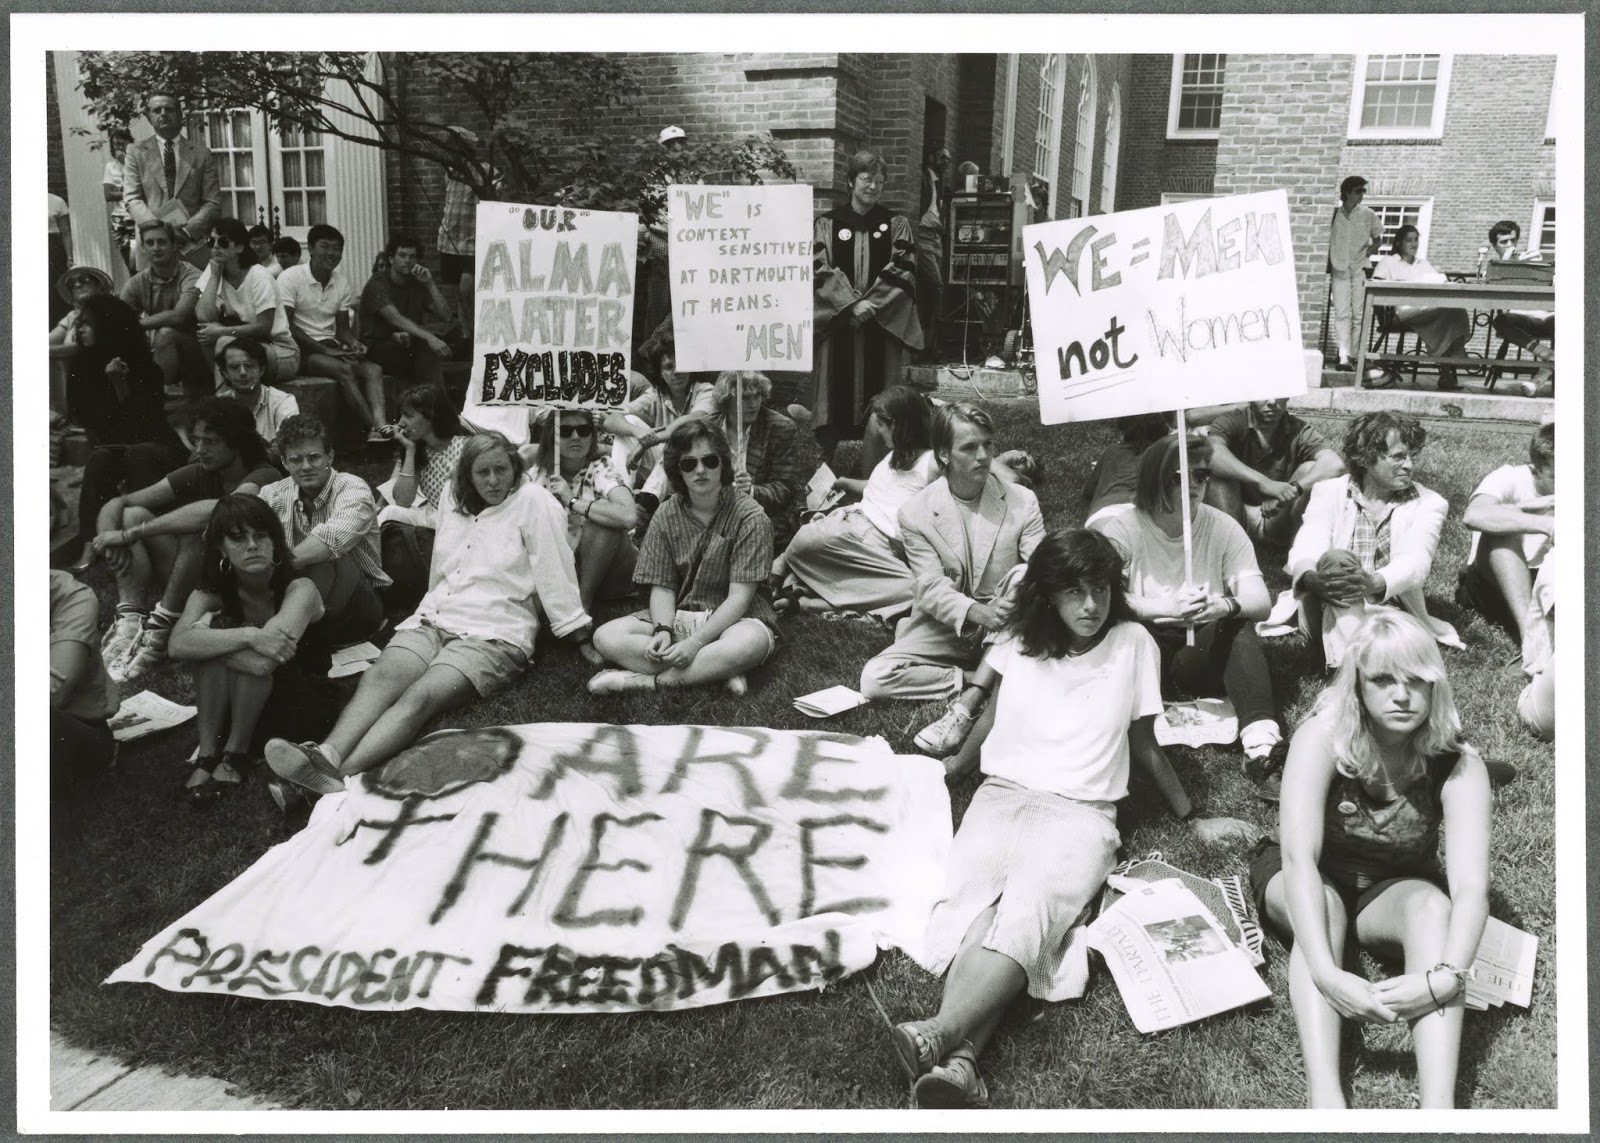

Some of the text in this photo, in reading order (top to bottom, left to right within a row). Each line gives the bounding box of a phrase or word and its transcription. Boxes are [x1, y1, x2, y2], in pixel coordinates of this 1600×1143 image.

[676, 227, 751, 243] CONTEXT
[747, 203, 762, 218] IS
[476, 239, 633, 298] ALMA
[680, 265, 810, 285] AT DARTMOUTH
[1033, 224, 1123, 297] WE
[1156, 206, 1286, 281] MEN
[475, 296, 631, 351] MATER
[682, 294, 780, 318] IT MEANS:
[1057, 297, 1291, 381] not Women
[481, 348, 628, 407] EXCLUDES
[528, 724, 890, 808] ARE
[476, 928, 846, 1006] FREEDMAN
